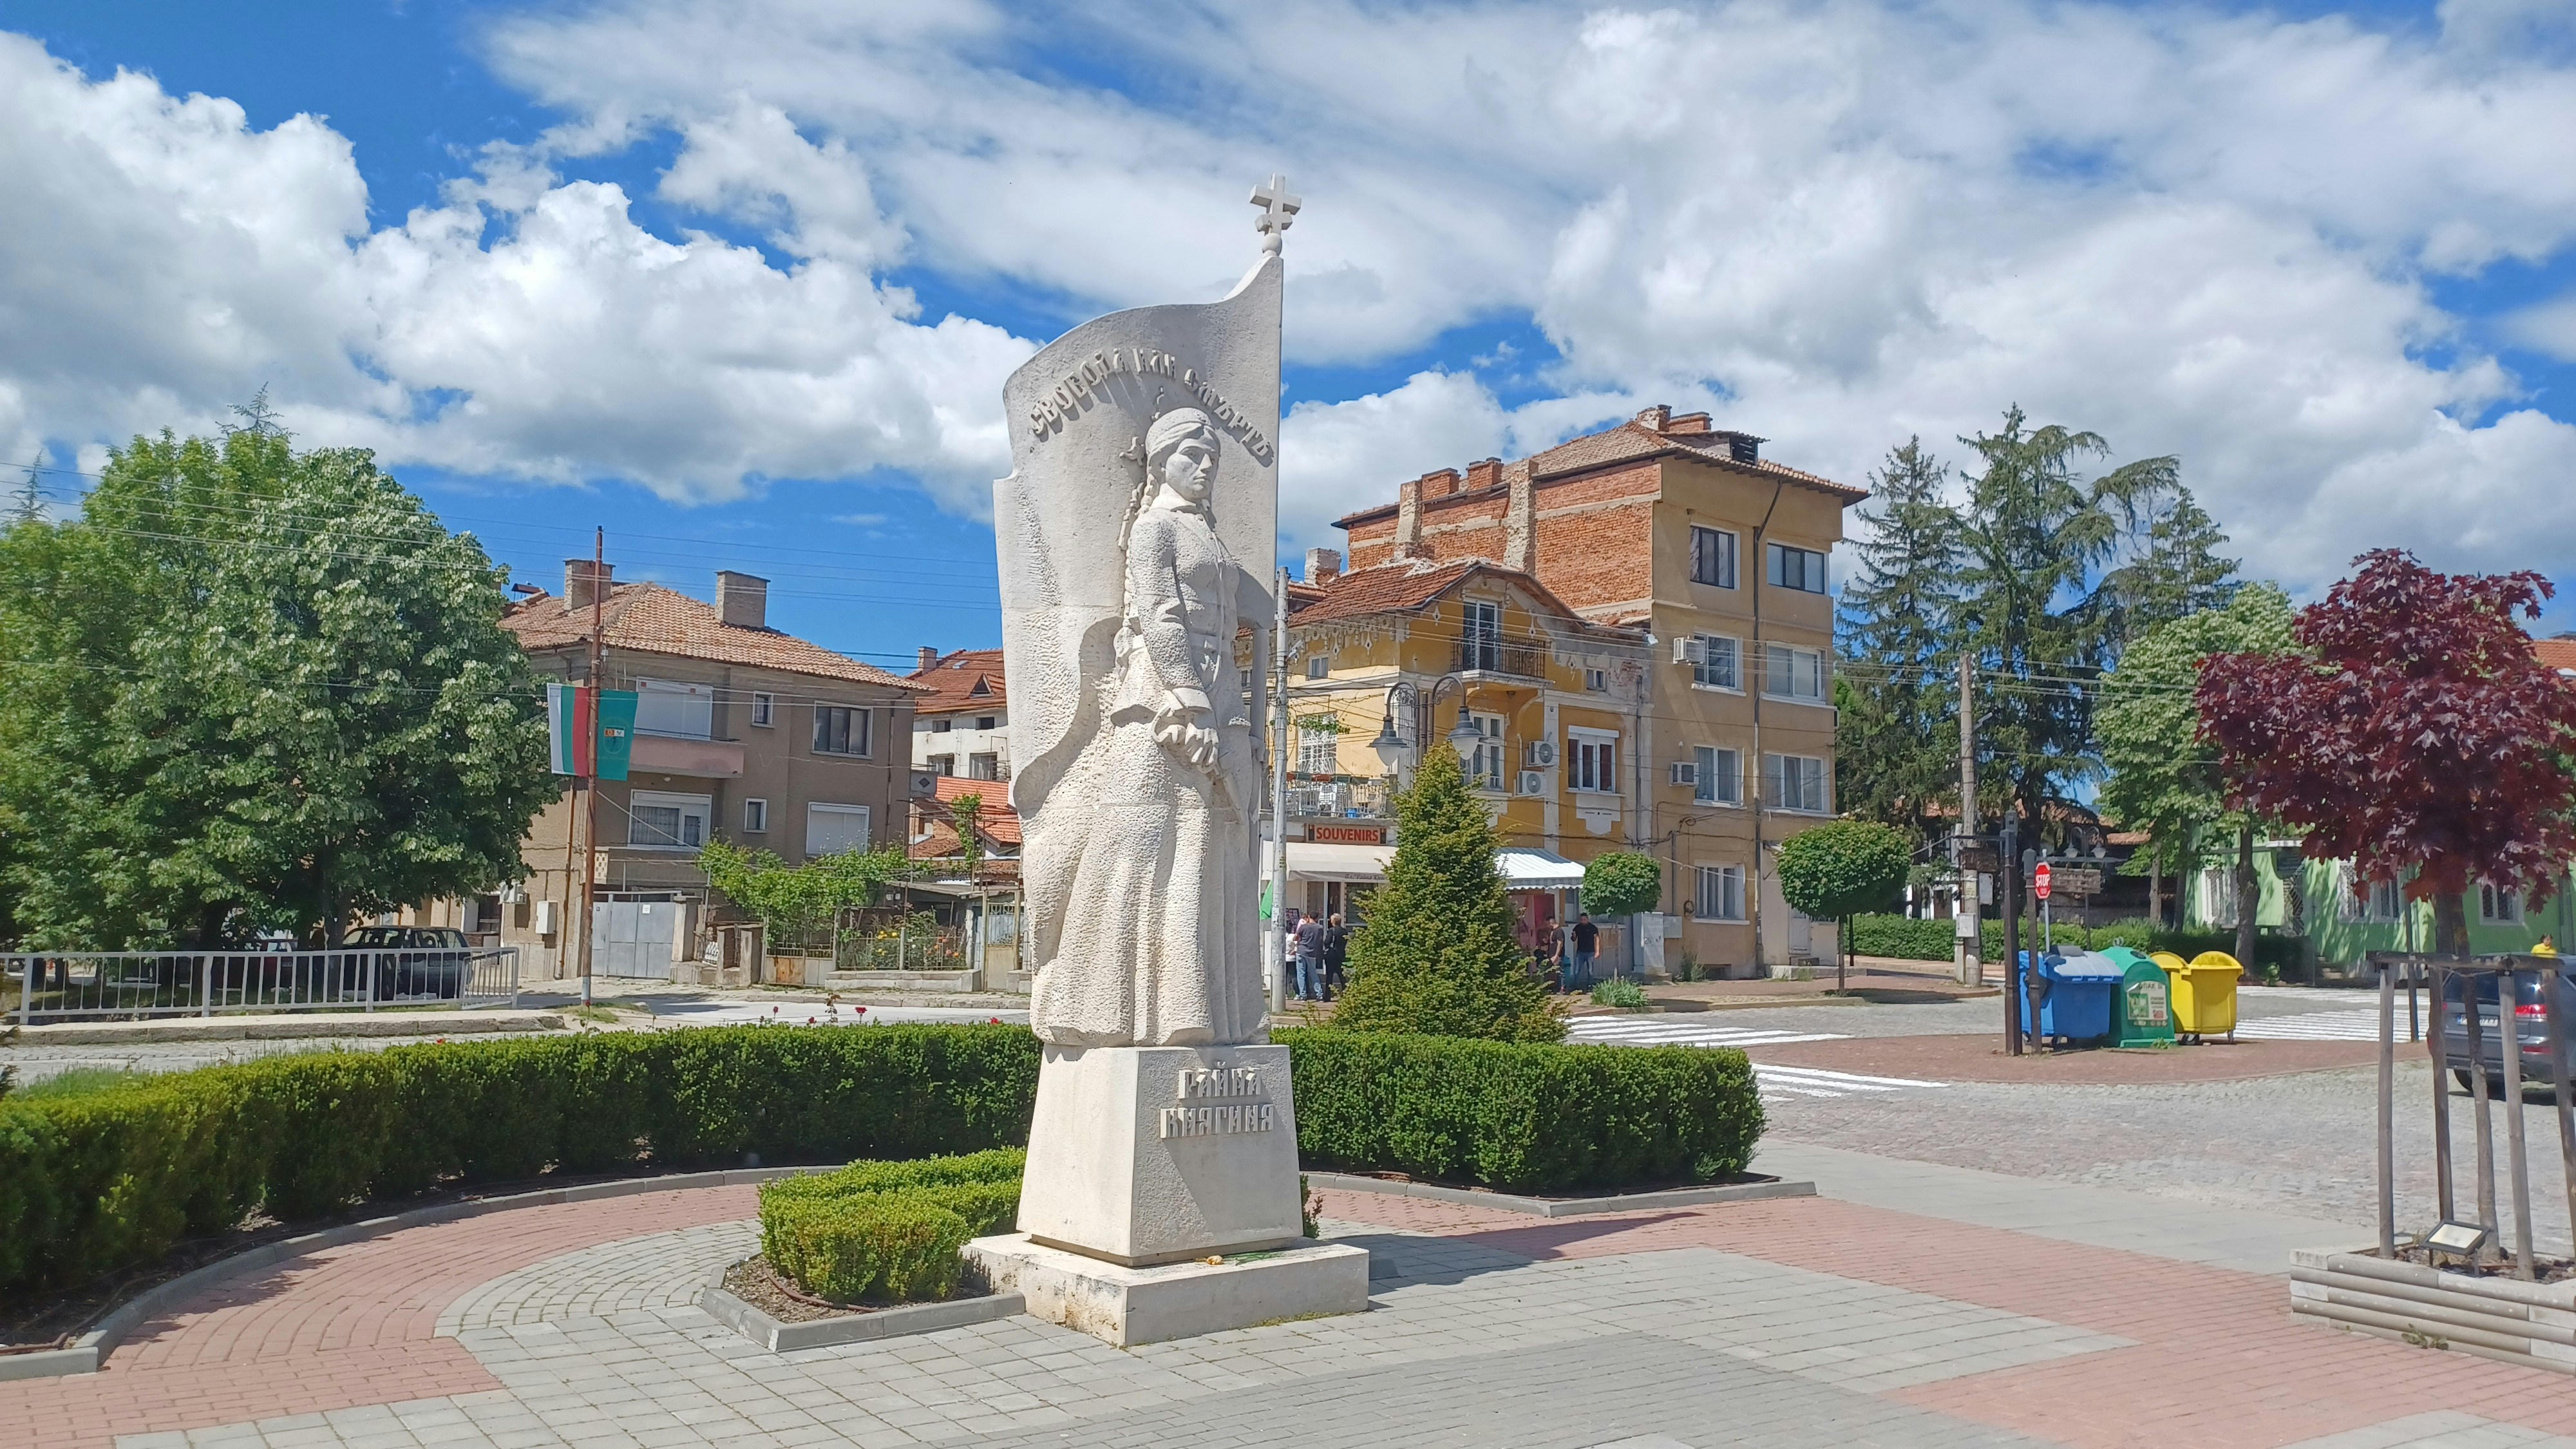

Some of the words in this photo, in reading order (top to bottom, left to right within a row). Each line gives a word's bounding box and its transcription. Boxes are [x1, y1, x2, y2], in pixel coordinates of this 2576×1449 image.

[1030, 348, 1128, 435] СВОБОДА
[1316, 828, 1378, 841] SOUVENIRS
[2036, 873, 2050, 887] STOP
[1179, 1061, 1262, 1099] РАЙНА
[1160, 1104, 1274, 1139] КНЯГИНЯ
